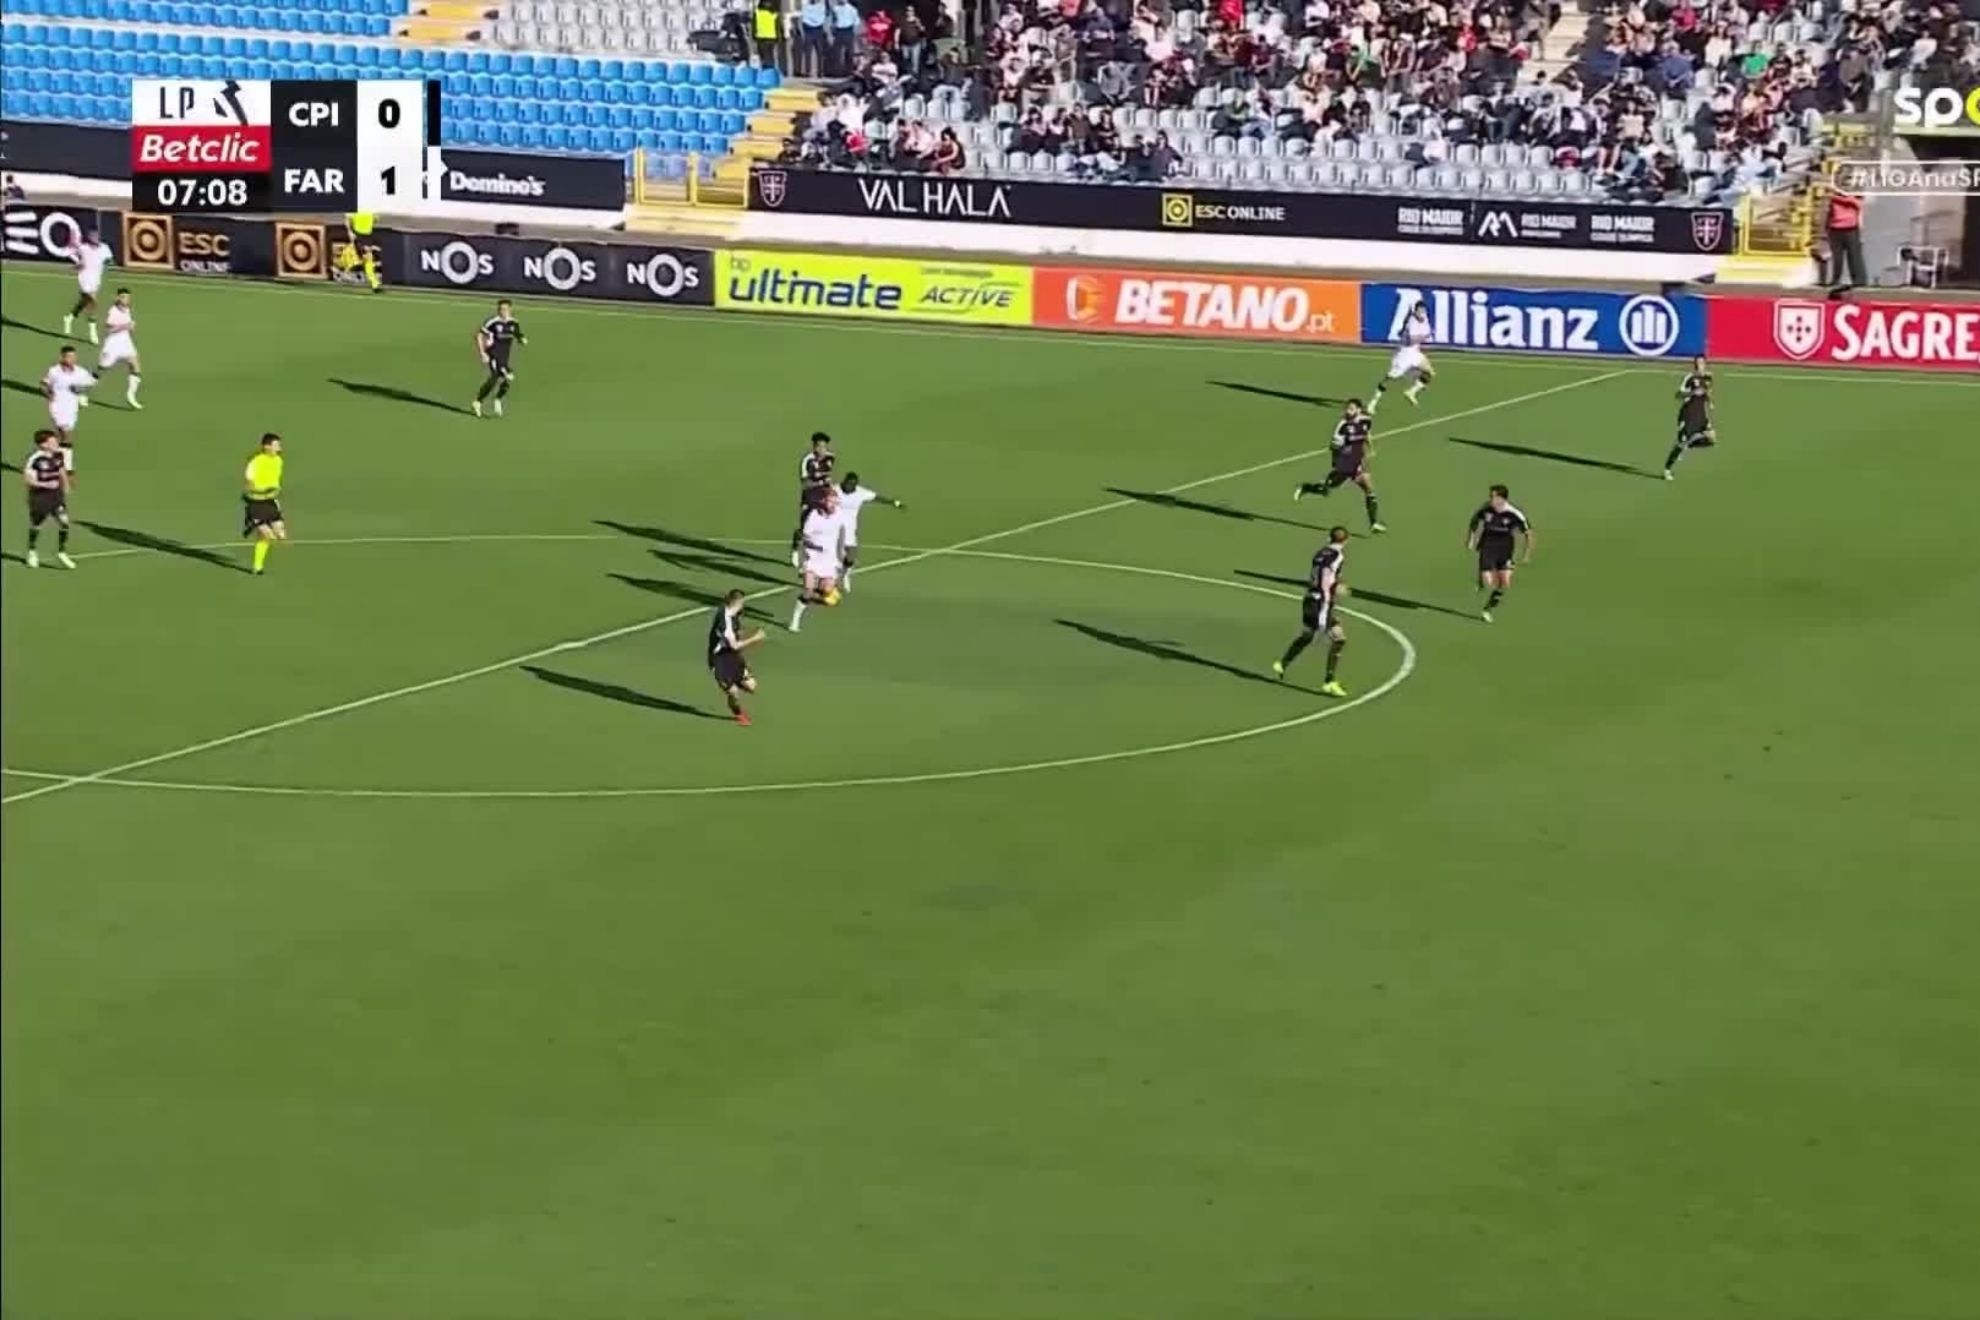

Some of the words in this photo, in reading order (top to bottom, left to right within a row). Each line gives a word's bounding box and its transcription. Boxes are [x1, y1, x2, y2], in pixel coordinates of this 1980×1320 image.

[449, 171, 546, 197] Domino's
[1195, 205, 1226, 218] ESC
[1227, 206, 1285, 220] ONLINE
[179, 232, 230, 256] ESC
[421, 241, 493, 285] NOS
[523, 248, 596, 291] NOS
[627, 253, 699, 297] NOS
[730, 267, 903, 310] ultimate
[919, 284, 1015, 308] ACTIVE
[1387, 288, 1599, 351] Allianz
[1832, 303, 1980, 362] SAGRE
